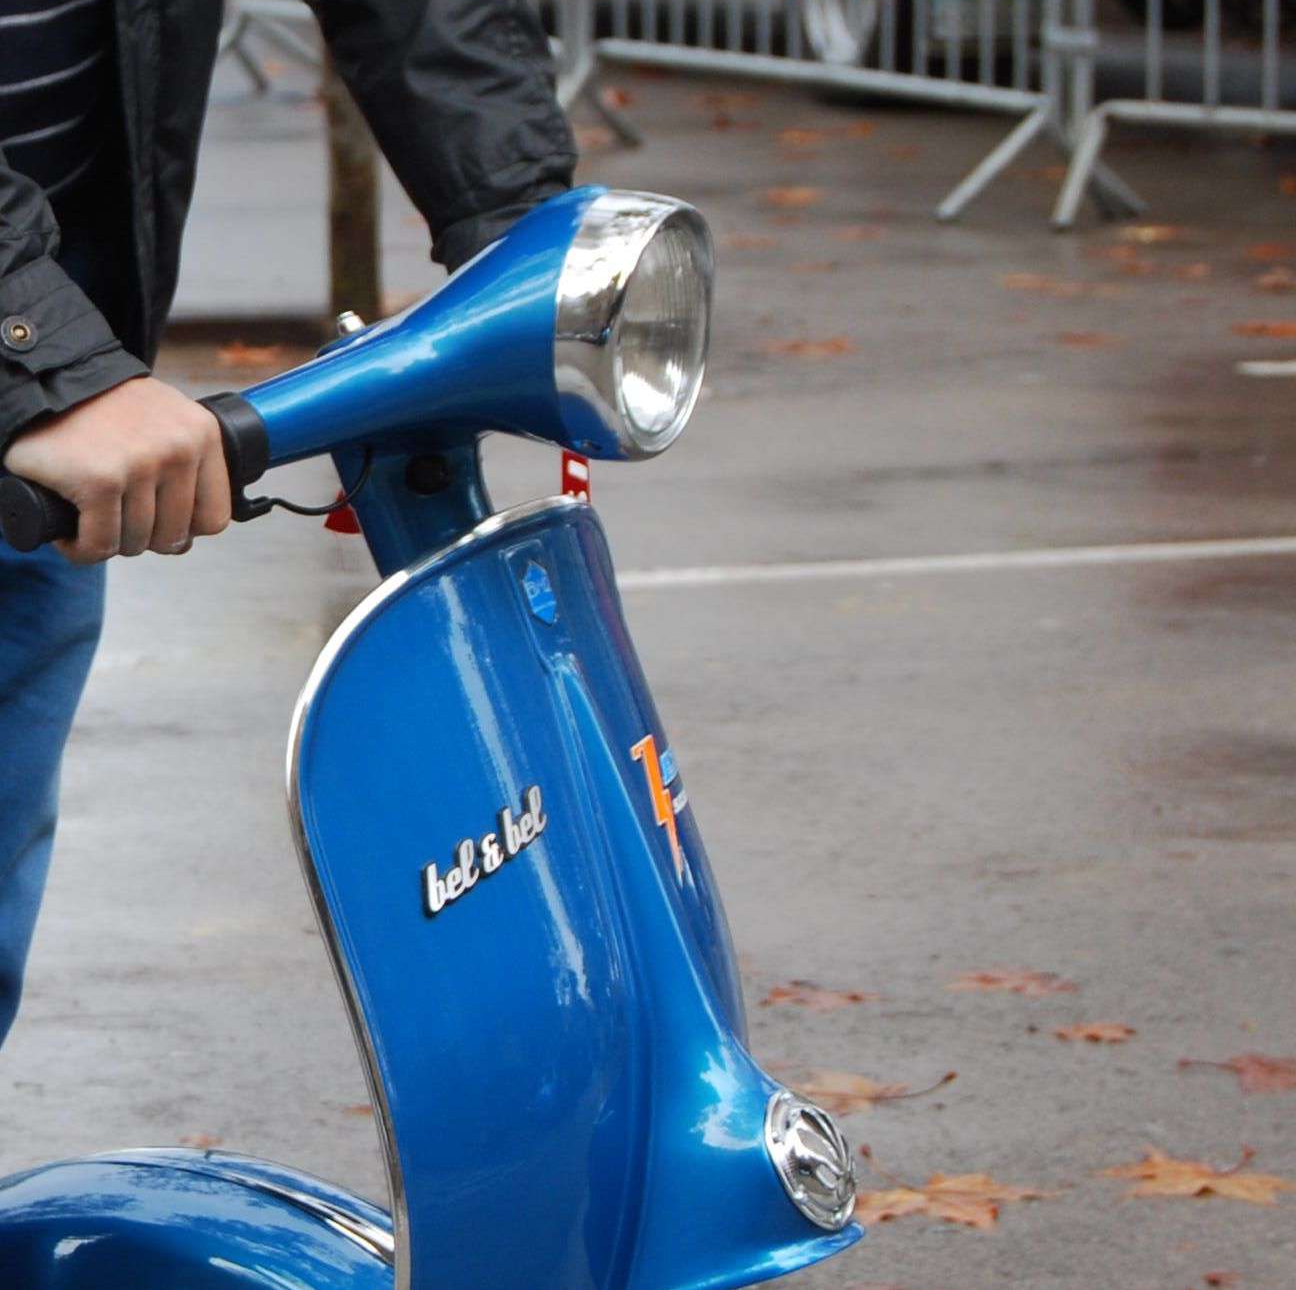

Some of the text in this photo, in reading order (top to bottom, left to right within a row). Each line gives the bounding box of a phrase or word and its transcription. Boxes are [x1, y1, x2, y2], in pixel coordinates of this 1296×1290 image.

[424, 784, 547, 913] bel & bel
